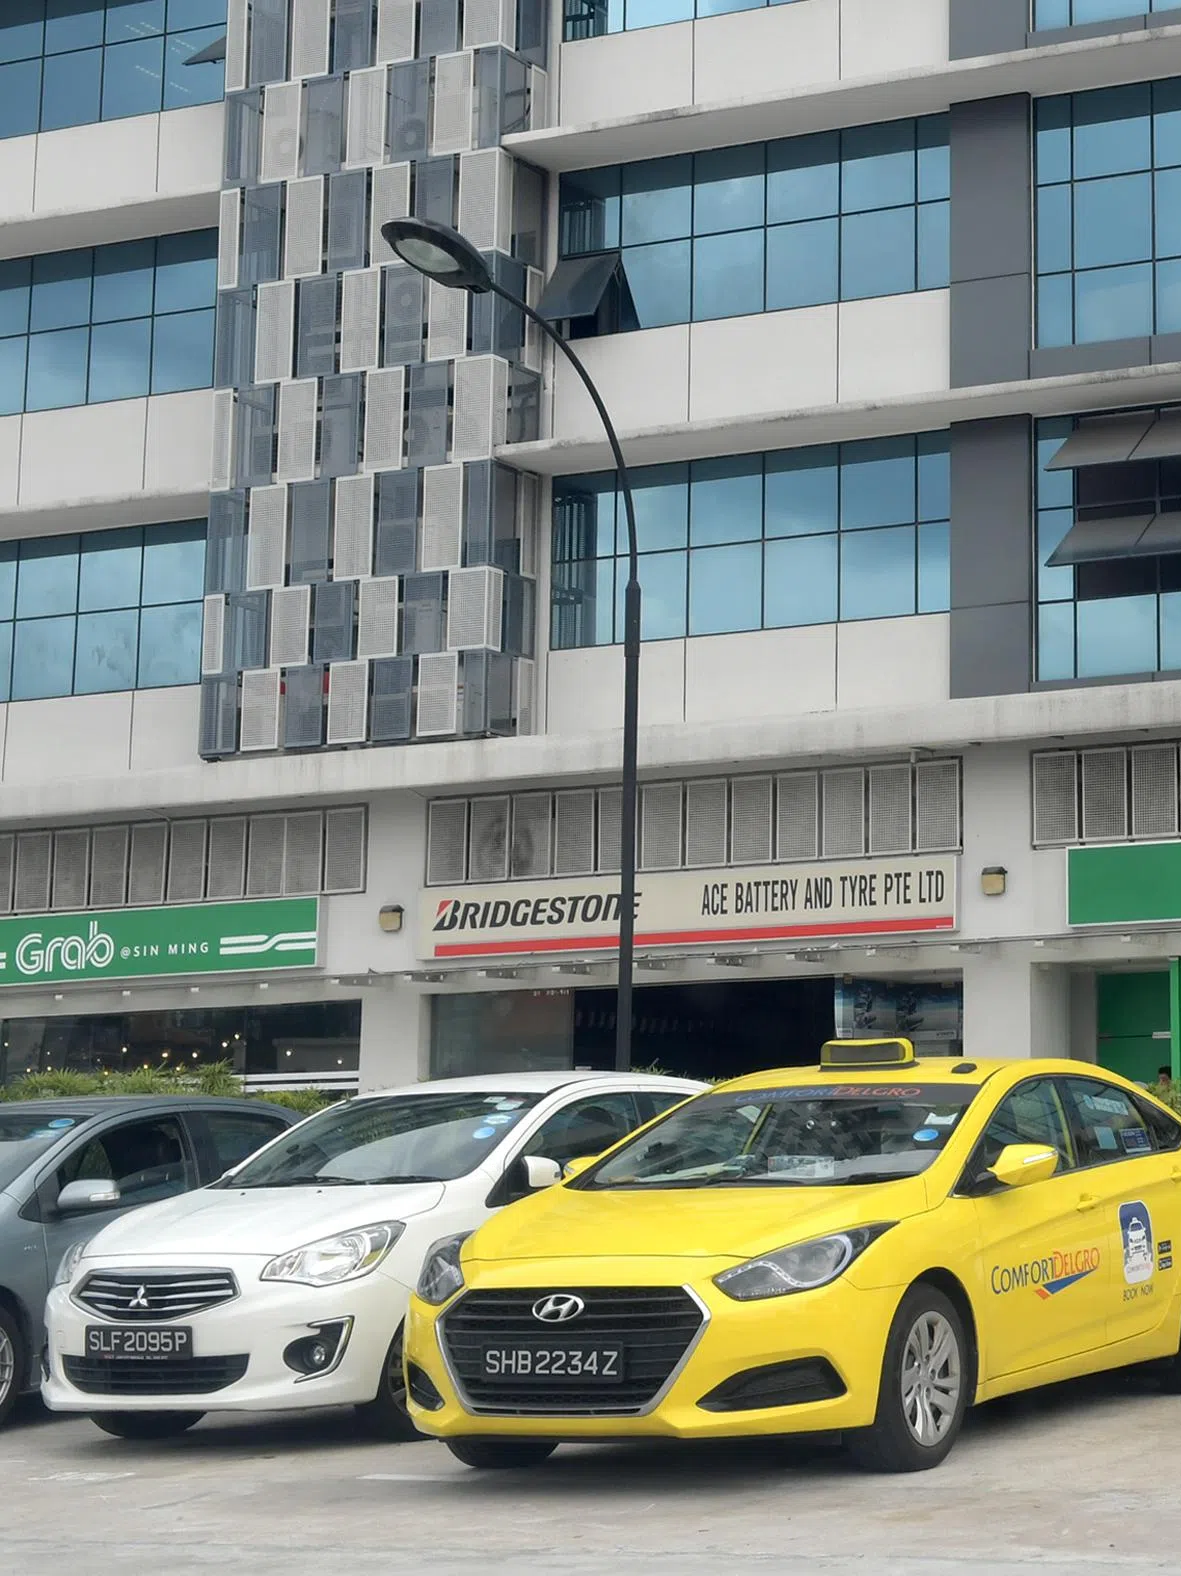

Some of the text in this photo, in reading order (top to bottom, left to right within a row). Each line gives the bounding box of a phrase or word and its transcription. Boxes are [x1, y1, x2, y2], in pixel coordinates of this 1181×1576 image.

[701, 869, 945, 916] ACE BATTERY AND TYRE PTE LTD
[15, 921, 114, 975] Grab
[168, 942, 209, 955] MING
[89, 1331, 187, 1352] SLF2095P
